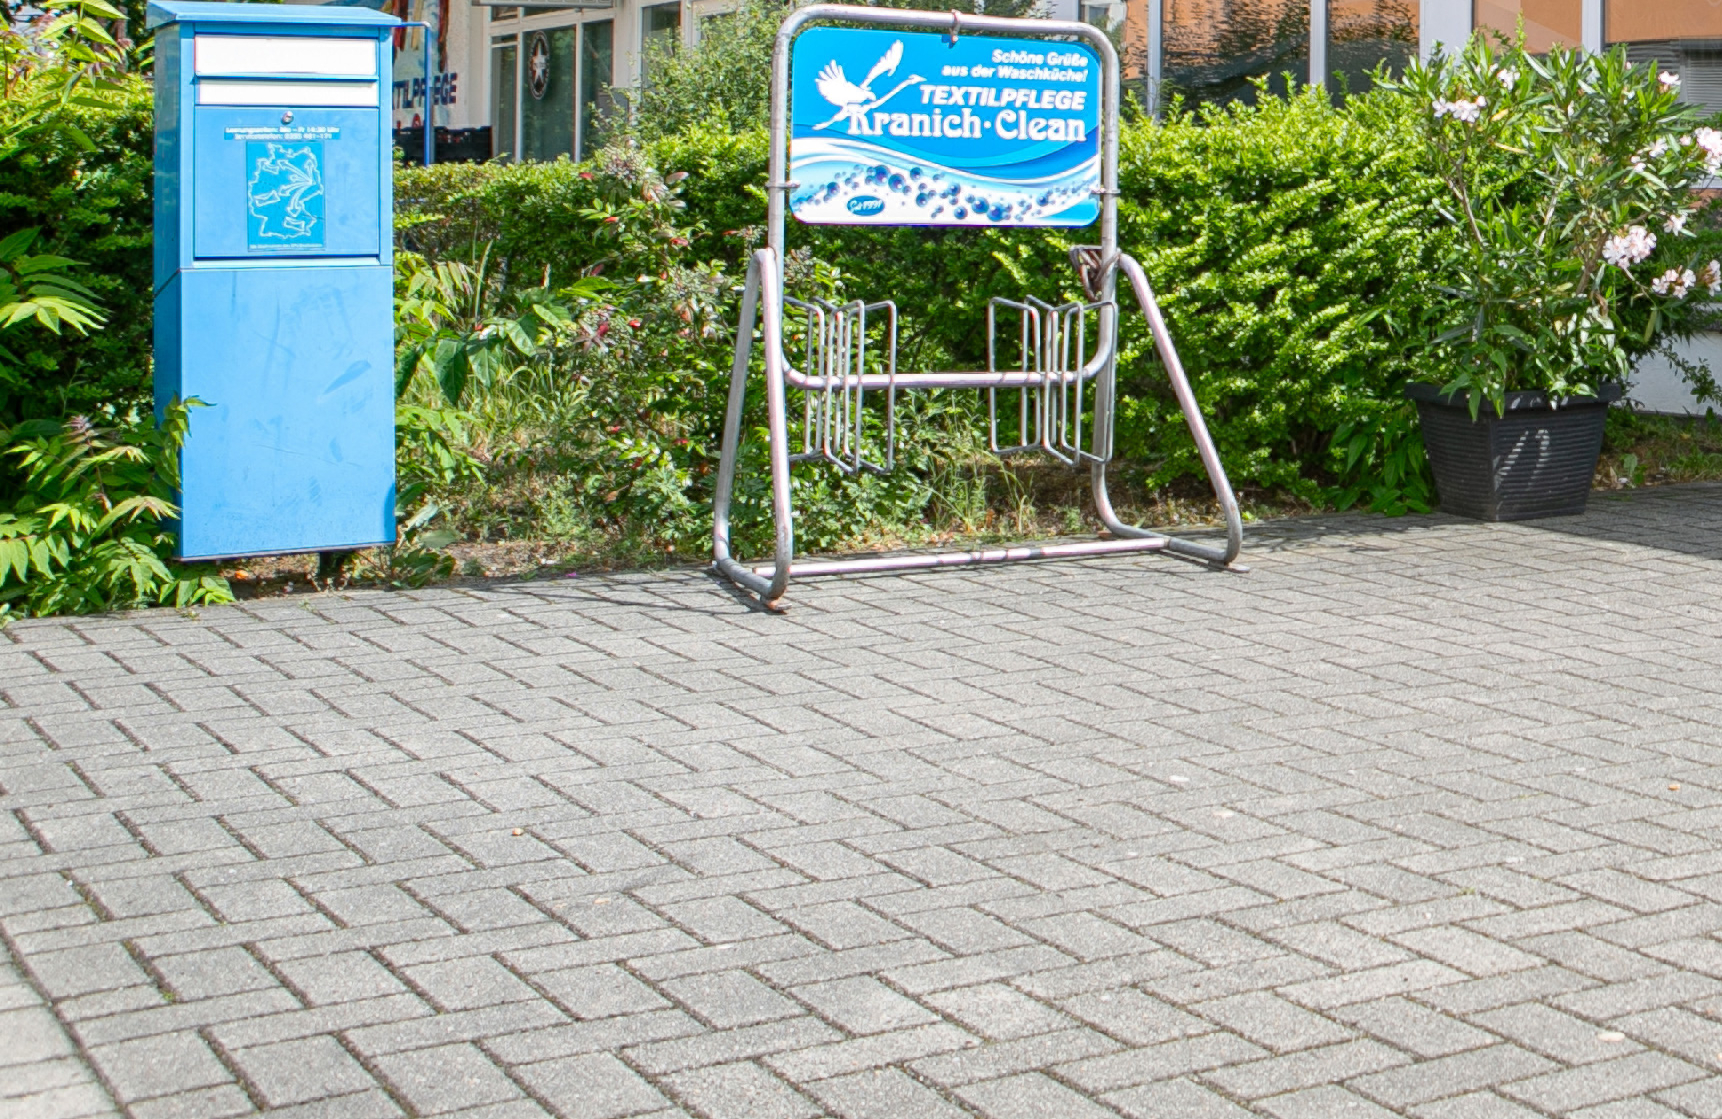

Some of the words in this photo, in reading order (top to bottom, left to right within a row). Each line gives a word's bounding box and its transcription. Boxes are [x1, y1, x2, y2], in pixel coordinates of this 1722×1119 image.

[991, 48, 1044, 65] Schöne
[1046, 52, 1089, 68] Grüße
[941, 66, 969, 78] aus
[971, 65, 996, 79] der
[997, 65, 1089, 83] Waschküche!
[919, 84, 1087, 110] TEXTILPFLEGE
